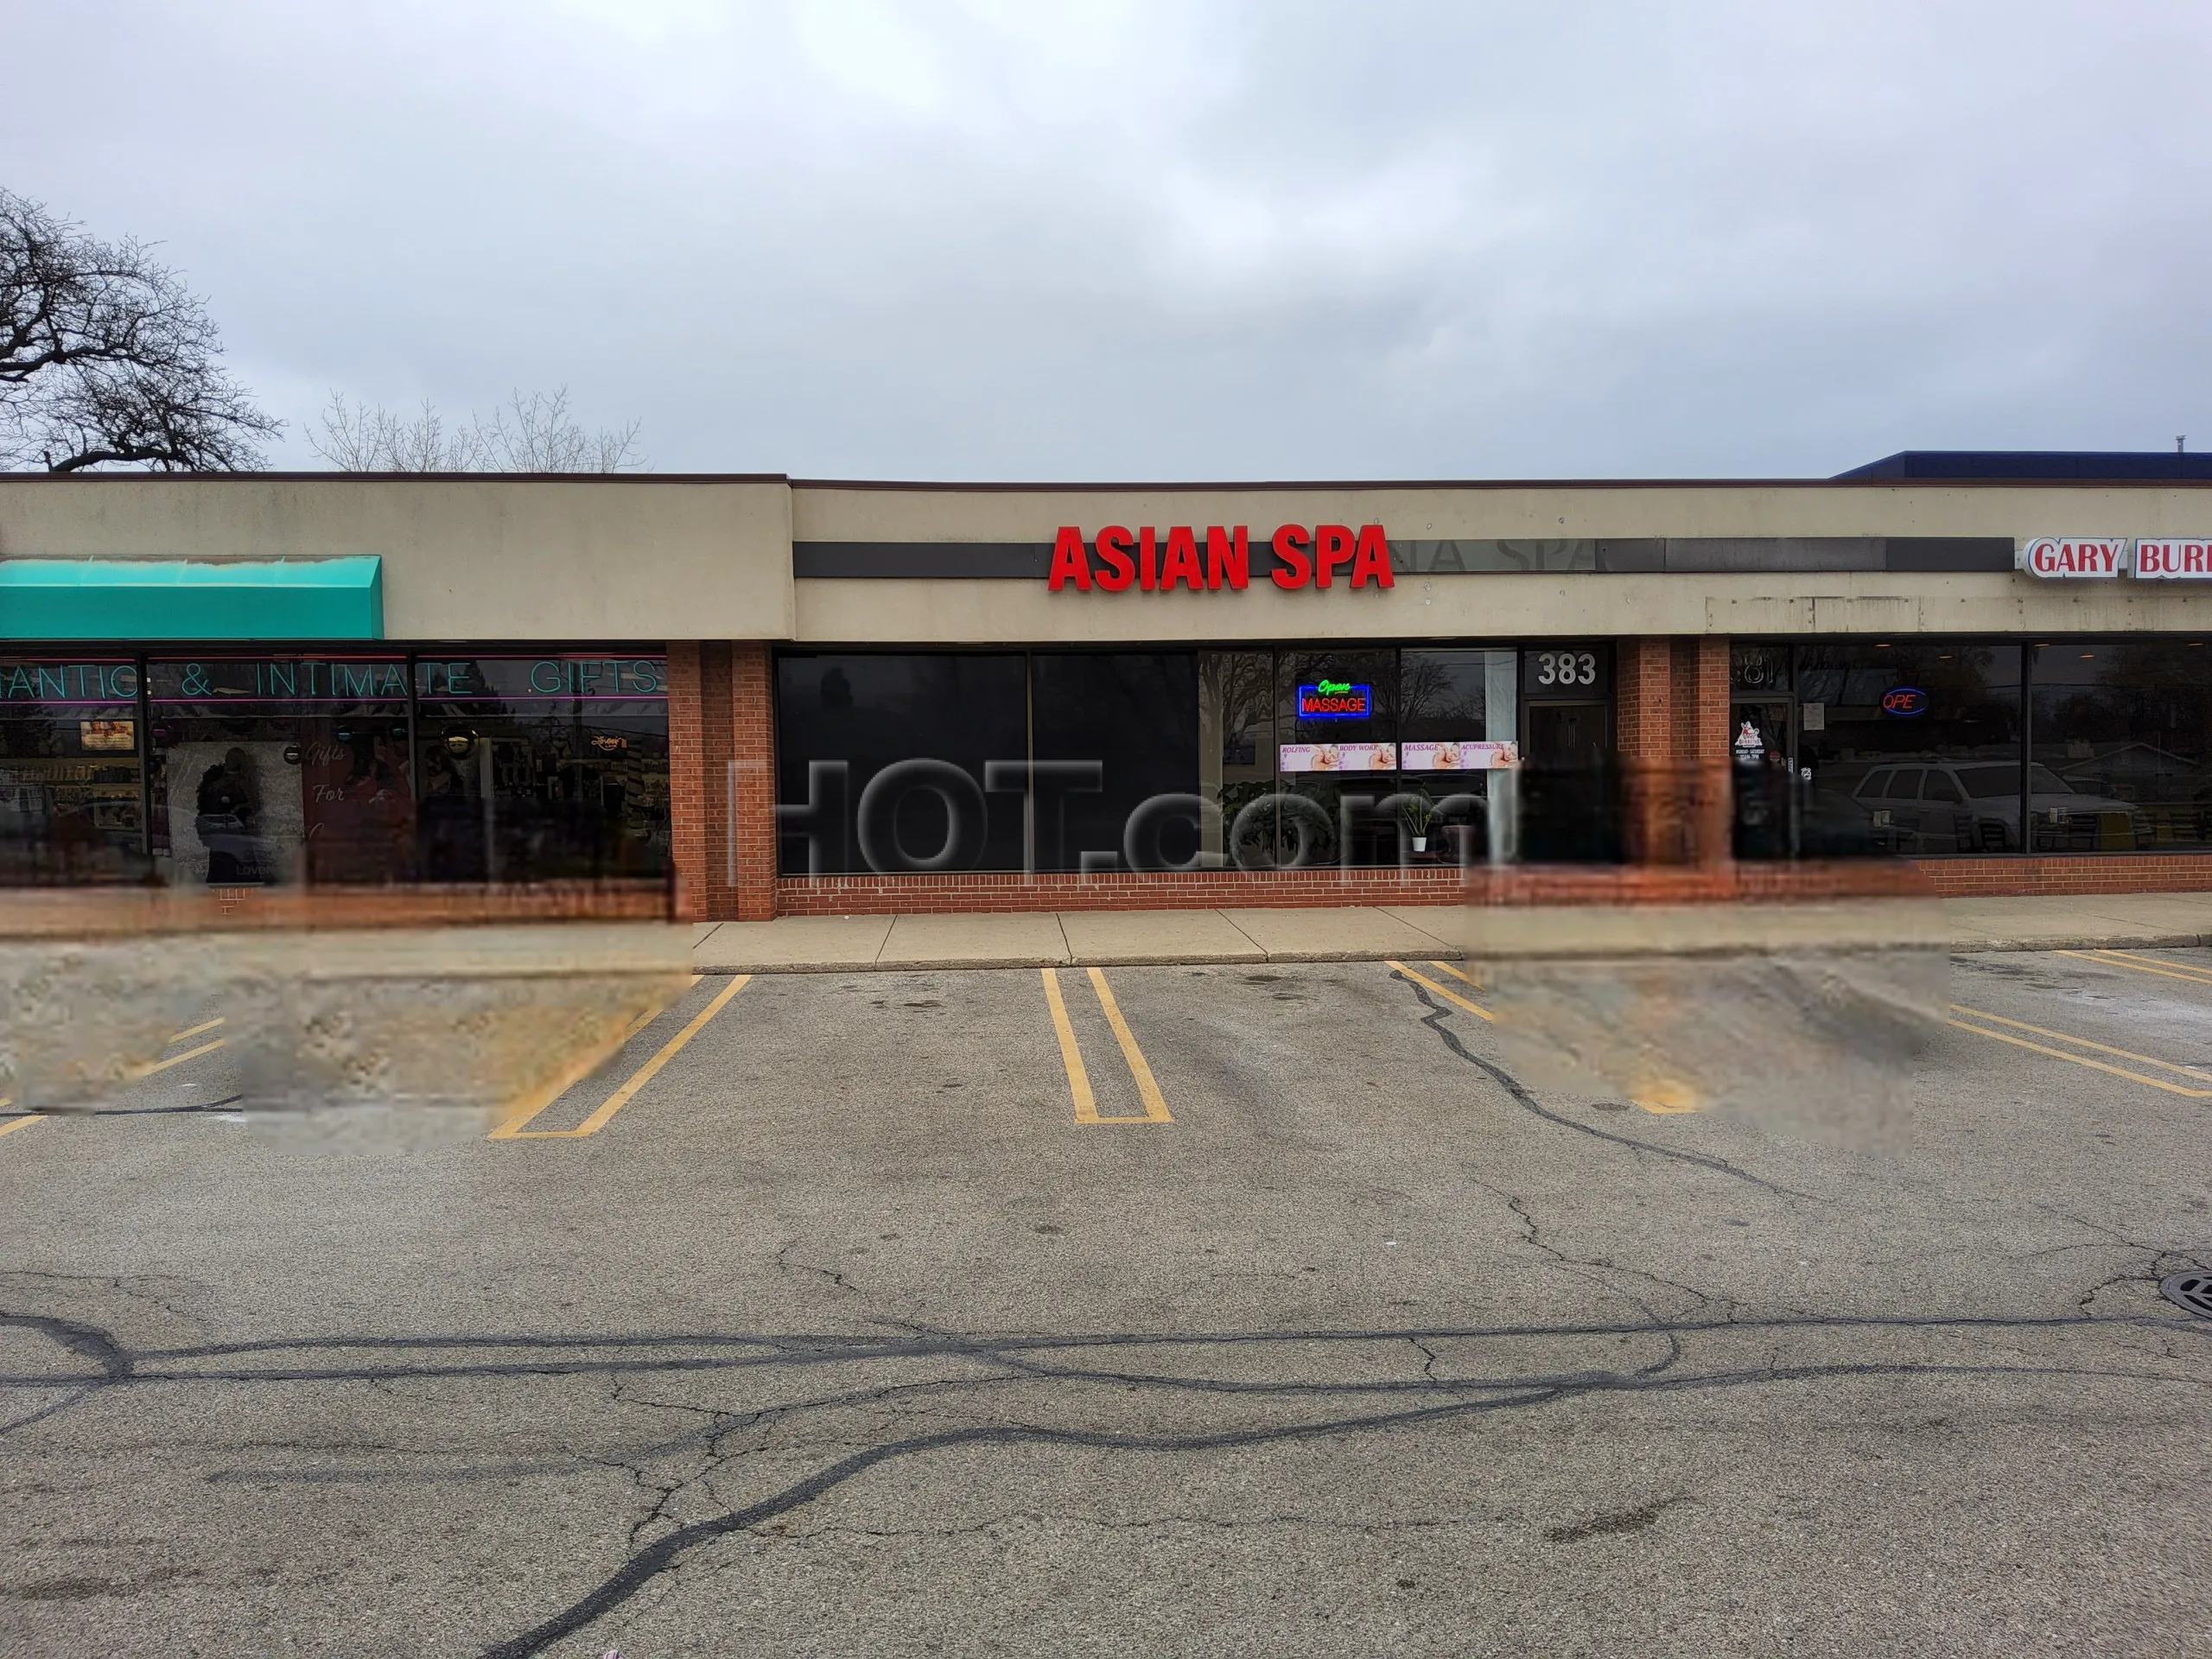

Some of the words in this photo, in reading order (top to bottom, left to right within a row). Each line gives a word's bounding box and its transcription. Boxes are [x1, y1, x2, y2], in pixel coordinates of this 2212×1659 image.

[1048, 524, 1249, 591] ASIAN
[1271, 524, 1395, 590] SPA
[2035, 543, 2119, 572] GARY
[2139, 543, 2212, 573] BUR
[1538, 652, 1597, 685] 383
[0, 664, 137, 698] ANTIC
[181, 663, 213, 696] &
[256, 662, 474, 696] INTIMATE
[531, 660, 658, 693] GIFTS
[1318, 679, 1351, 696] Open
[1301, 697, 1366, 712] MASSAGE
[1884, 694, 1916, 709] OPE
[305, 741, 346, 766] Gifts
[1403, 743, 1439, 752] MASSAGE
[1461, 742, 1505, 751] ACUPRESSURE
[313, 784, 345, 804] For
